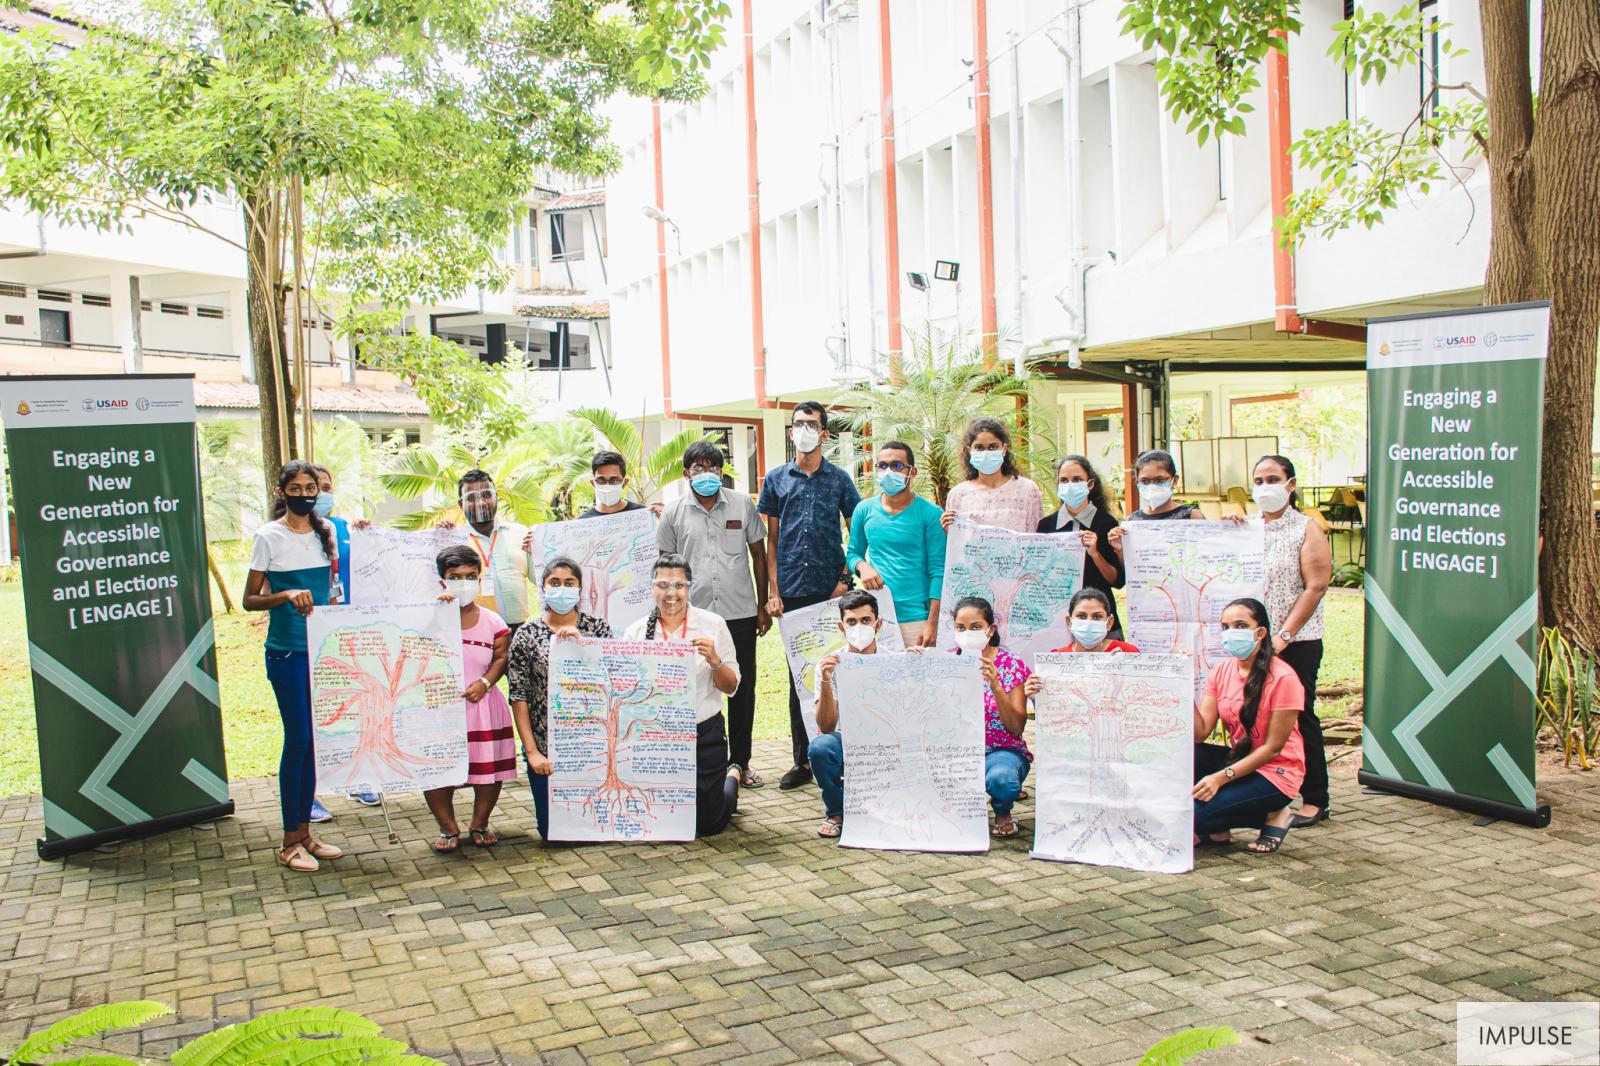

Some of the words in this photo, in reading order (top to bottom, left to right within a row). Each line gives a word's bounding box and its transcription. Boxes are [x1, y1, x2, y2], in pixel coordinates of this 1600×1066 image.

[1446, 335, 1476, 345] USAID
[96, 399, 129, 408] USAID
[1403, 386, 1482, 410] Engaging
[1486, 389, 1498, 404] a
[1431, 415, 1472, 433] New
[53, 447, 140, 470] Engaging
[144, 449, 156, 462] a
[1388, 442, 1485, 462] Generation
[1489, 441, 1519, 461] for
[88, 474, 132, 491] New
[1402, 469, 1494, 489] Accessible
[40, 499, 149, 522] Generation
[153, 495, 180, 513] for
[1395, 497, 1501, 518] Governance
[62, 523, 161, 547] Accessible
[1390, 524, 1423, 542] and
[1426, 524, 1506, 547] Elections
[56, 549, 171, 574] Governance
[1413, 551, 1486, 574] ENGAGE
[53, 580, 90, 601] and
[95, 573, 179, 597] Elections
[82, 598, 161, 624] ENGAGE
